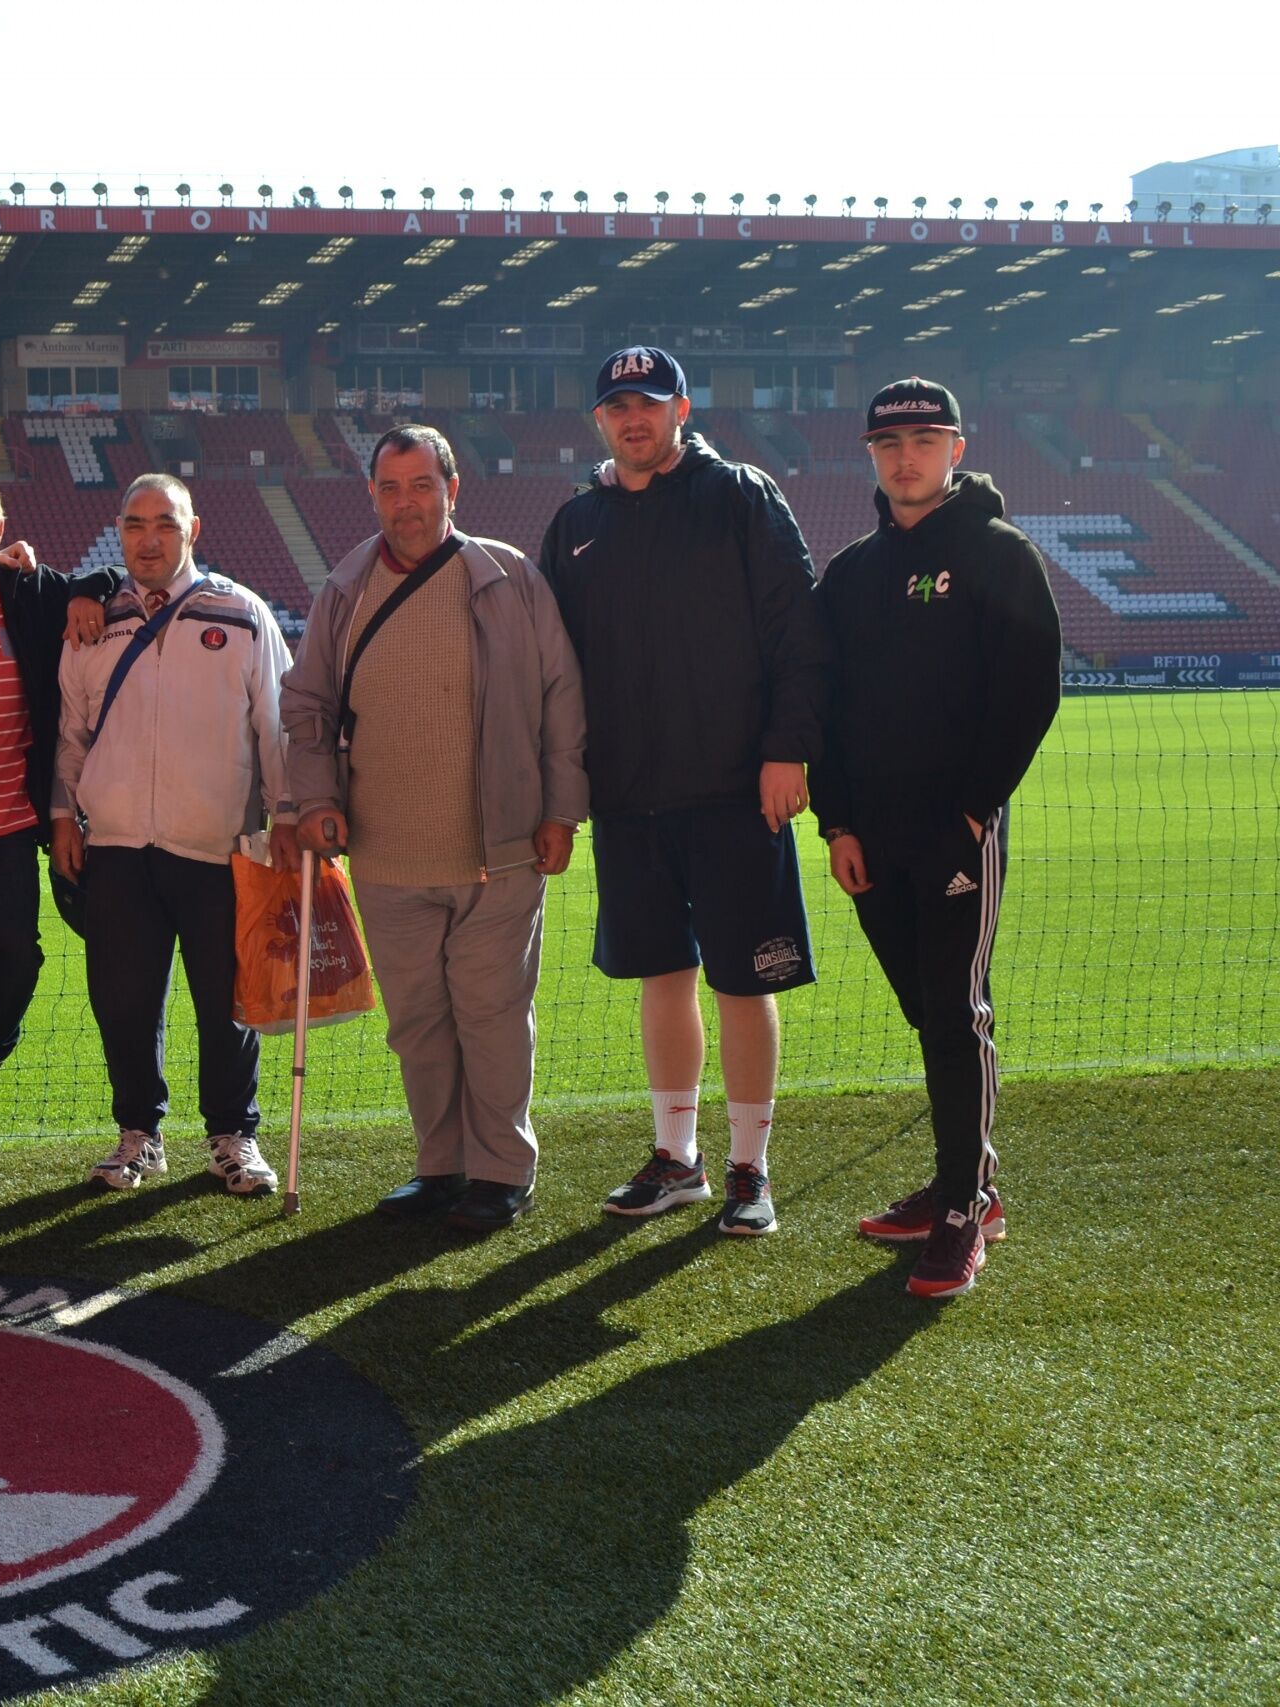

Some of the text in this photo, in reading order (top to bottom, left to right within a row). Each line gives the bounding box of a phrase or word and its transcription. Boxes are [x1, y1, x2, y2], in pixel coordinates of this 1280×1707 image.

[403, 213, 752, 237] ATHLETIC
[866, 221, 1193, 245] FOOTBALL
[40, 340, 119, 354] Anthony Martin
[612, 355, 655, 380] GAP
[907, 570, 950, 603] C4C
[1124, 671, 1166, 684] hummel
[753, 944, 801, 972] LONSDALE
